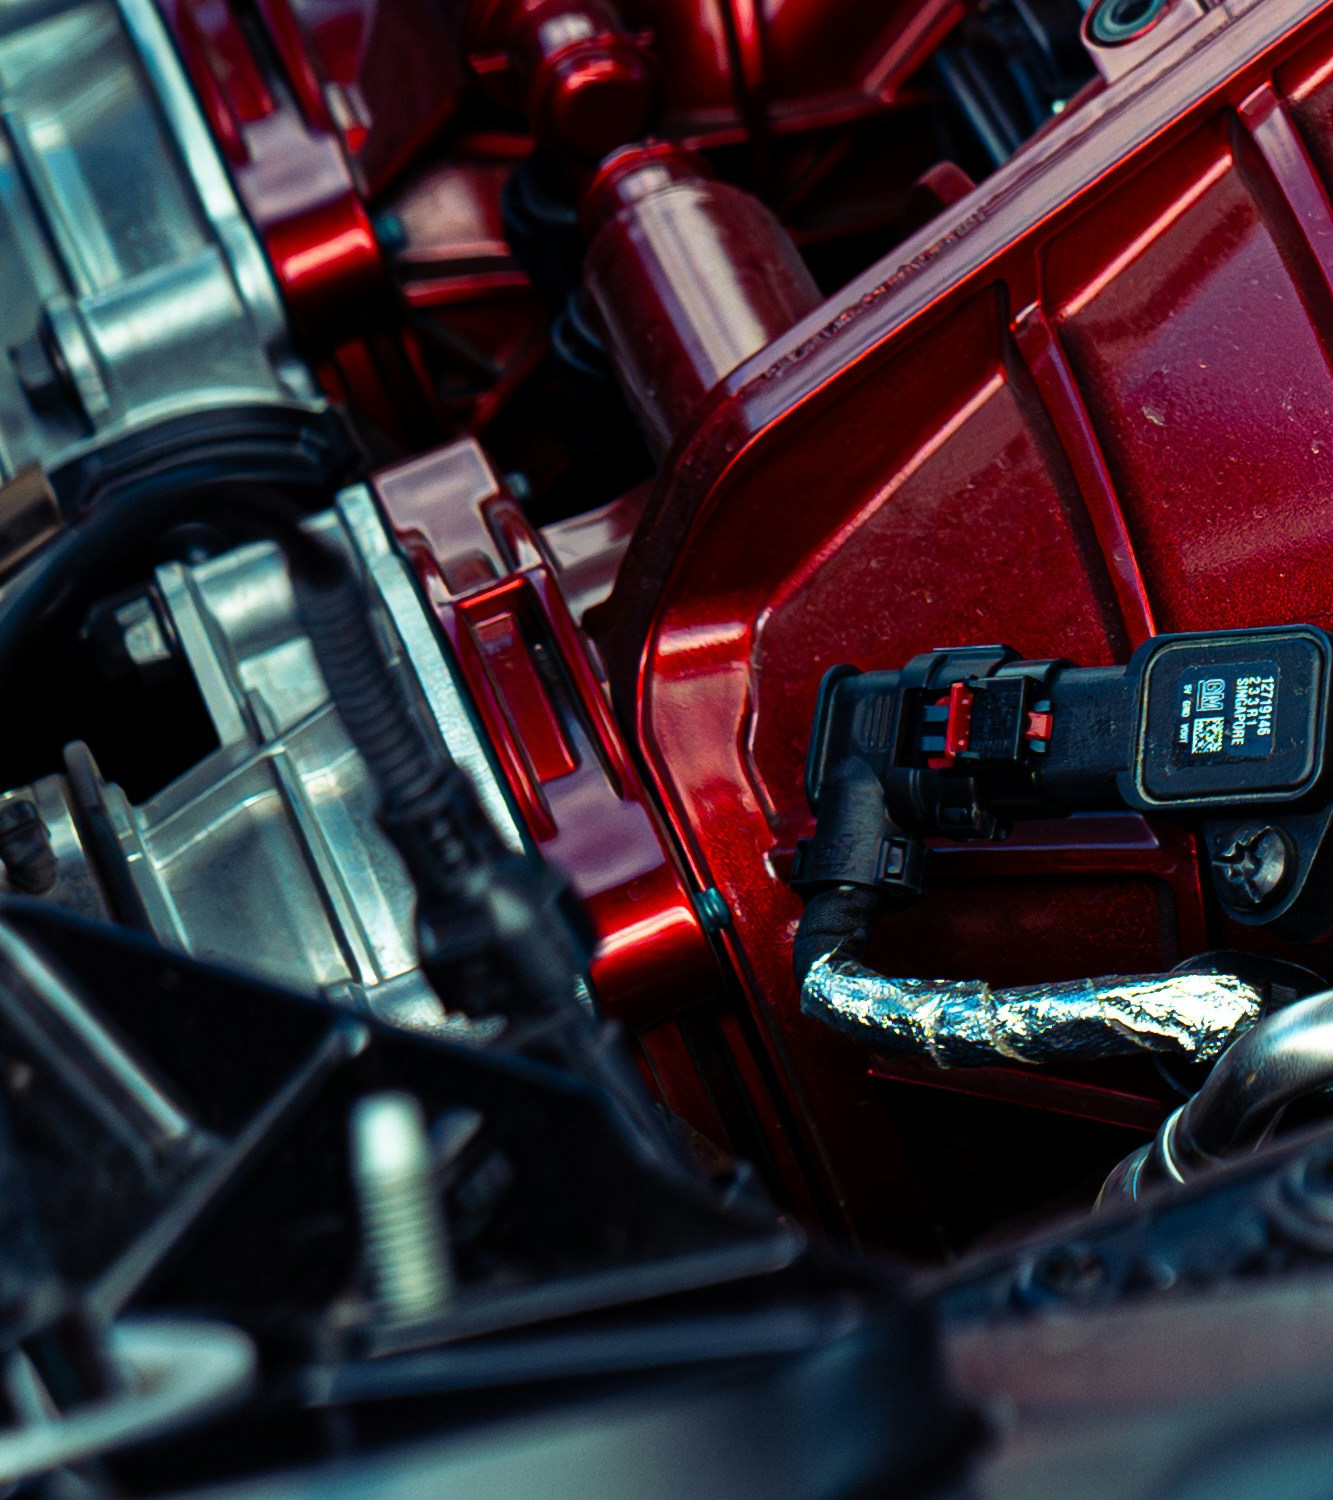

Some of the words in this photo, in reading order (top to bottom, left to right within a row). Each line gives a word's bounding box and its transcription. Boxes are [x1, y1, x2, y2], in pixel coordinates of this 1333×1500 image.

[1197, 678, 1226, 712] GM
[1230, 677, 1250, 746] SINGAPORE
[1257, 676, 1275, 736] 12719146
